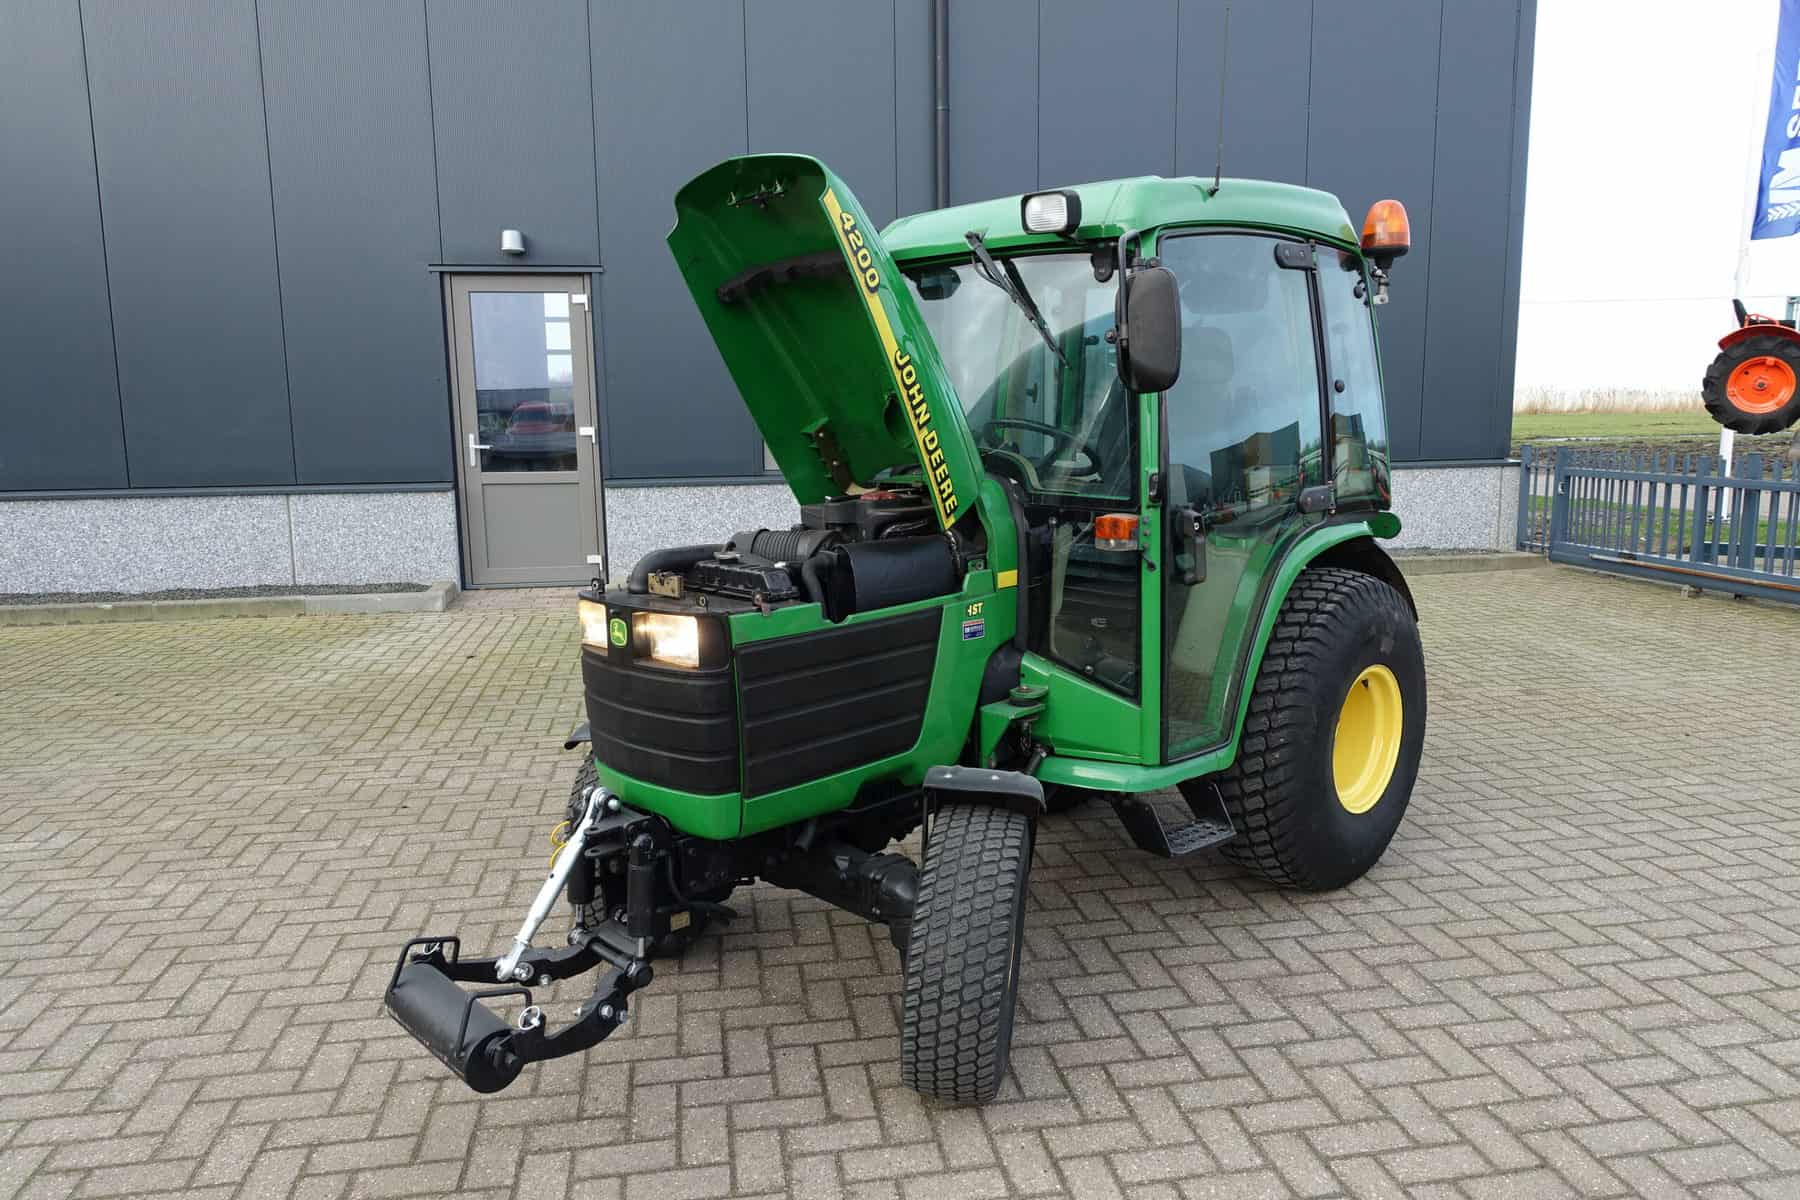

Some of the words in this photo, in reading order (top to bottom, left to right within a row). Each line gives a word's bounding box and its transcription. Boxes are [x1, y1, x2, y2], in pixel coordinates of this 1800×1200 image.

[840, 211, 881, 292] 4200
[895, 349, 931, 429] JOHN
[923, 430, 959, 518] DEERE
